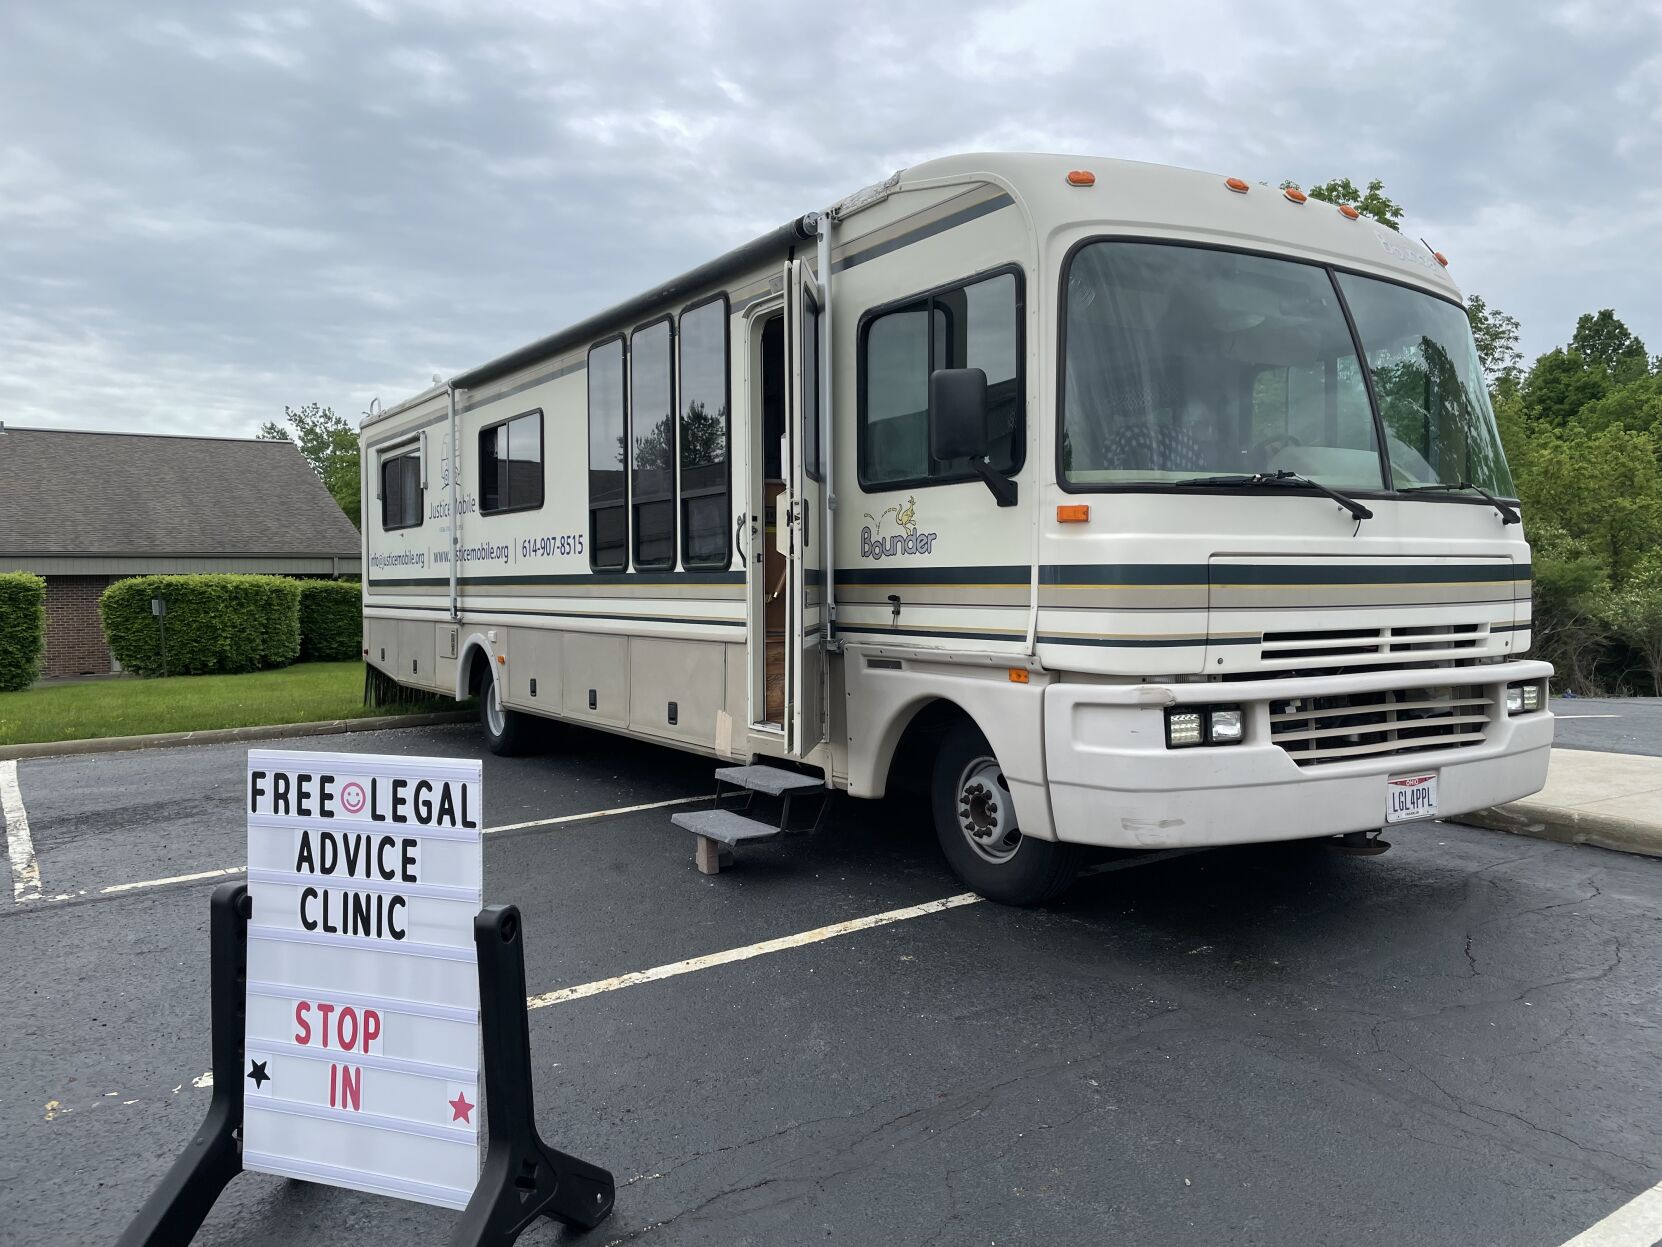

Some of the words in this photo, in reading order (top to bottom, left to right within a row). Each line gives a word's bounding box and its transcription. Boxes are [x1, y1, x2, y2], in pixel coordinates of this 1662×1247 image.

[455, 493, 476, 515] obile
[370, 549, 425, 570] info@justicemobile.org
[433, 541, 509, 565] www.sticemobile.org
[522, 534, 584, 558] 614-907-8515
[860, 526, 938, 561] Bounder
[251, 770, 336, 819] FREE
[370, 777, 477, 829] LEGAL
[1392, 786, 1433, 813] LGL4PPL
[1405, 778, 1419, 786] OHIO
[296, 830, 418, 883] ADVICE
[299, 887, 407, 940] CLINIC
[294, 1000, 381, 1054] STOP
[329, 1063, 362, 1112] IN
